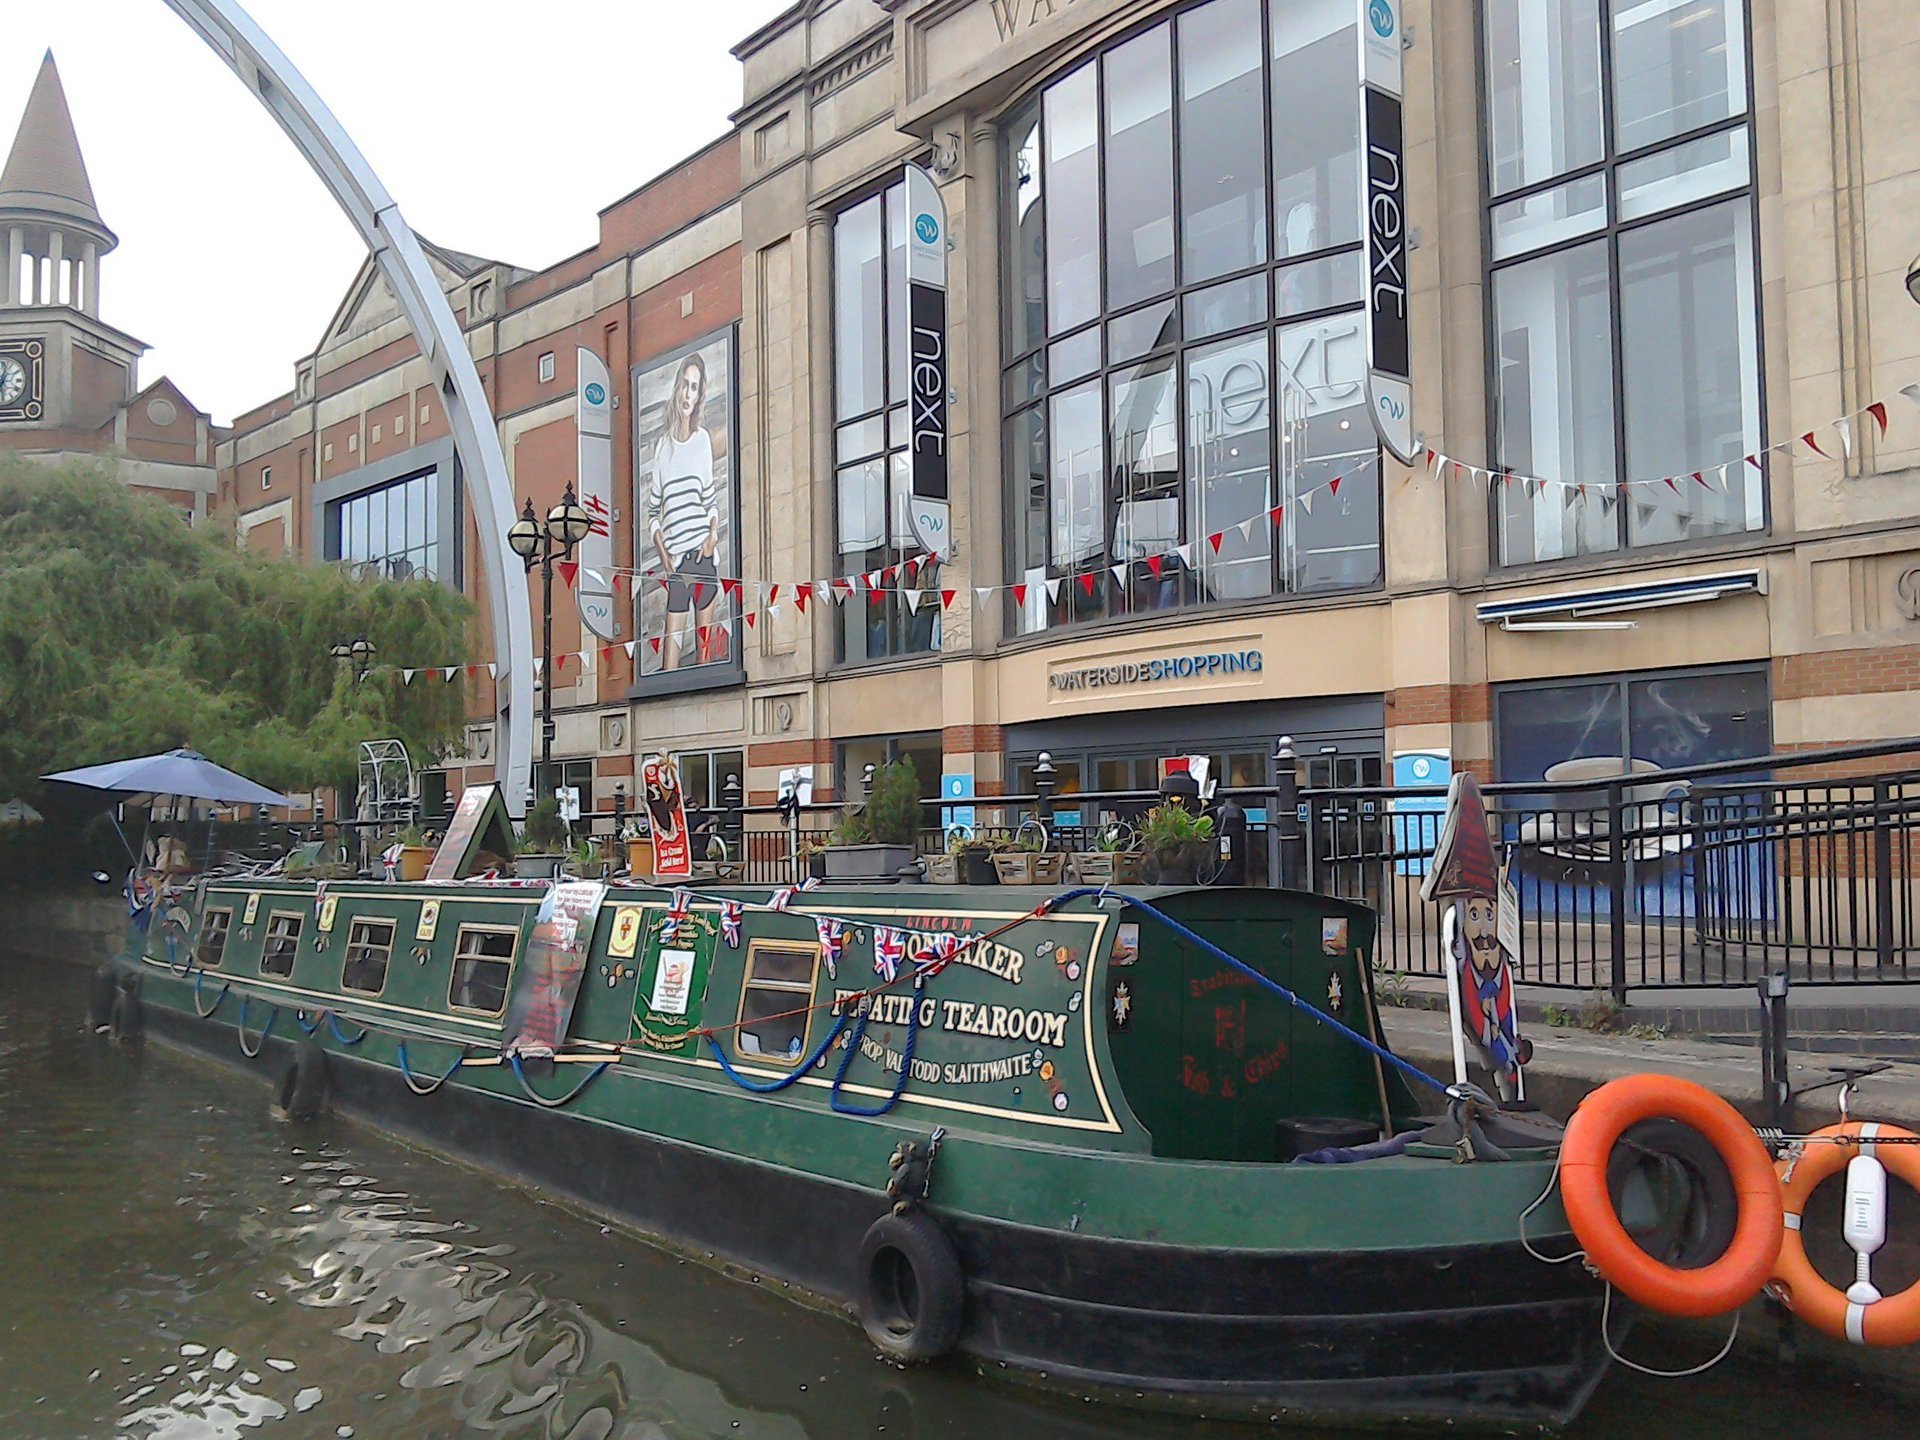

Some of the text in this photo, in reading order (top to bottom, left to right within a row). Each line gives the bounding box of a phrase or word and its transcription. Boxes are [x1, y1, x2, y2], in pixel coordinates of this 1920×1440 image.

[1370, 144, 1404, 319] next
[914, 326, 945, 457] next
[906, 915, 973, 932] LINCOLN
[943, 1000, 1067, 1047] TEAROOM
[886, 1048, 904, 1074] VAL
[909, 1058, 941, 1084] TODD
[943, 1053, 1033, 1084] SLAITHWAITE
